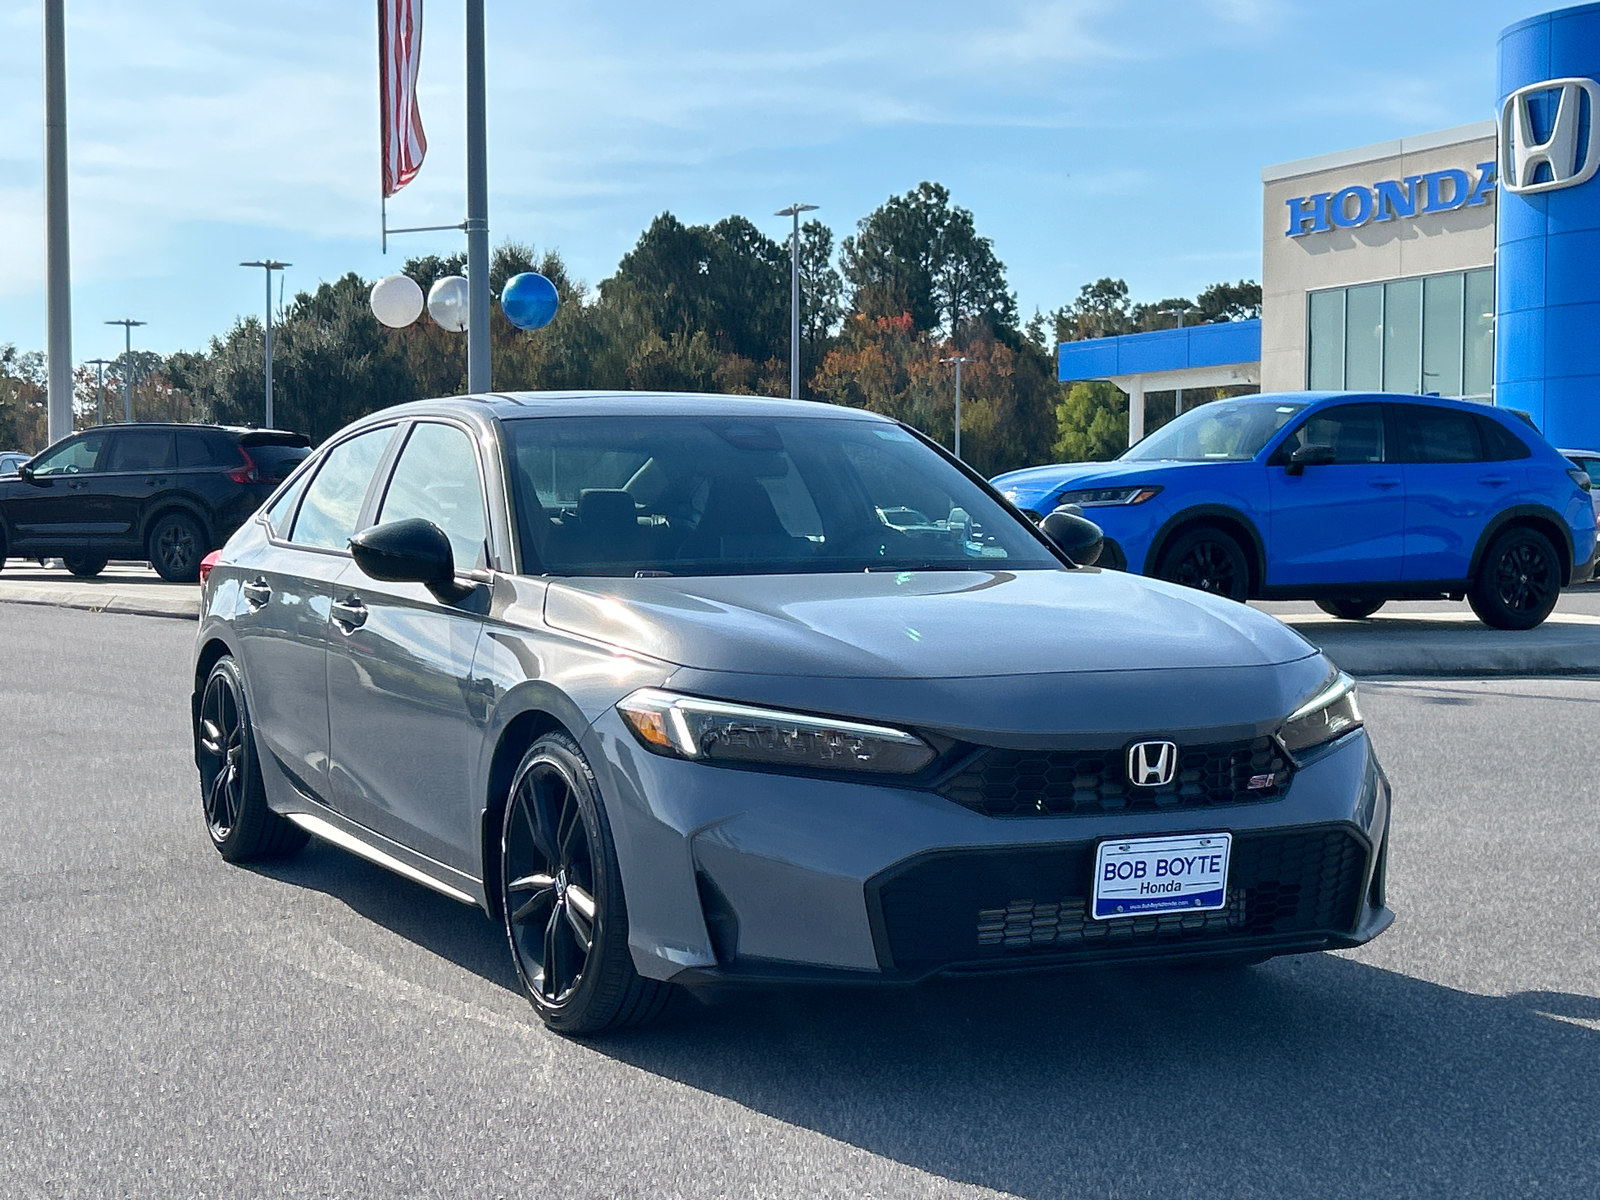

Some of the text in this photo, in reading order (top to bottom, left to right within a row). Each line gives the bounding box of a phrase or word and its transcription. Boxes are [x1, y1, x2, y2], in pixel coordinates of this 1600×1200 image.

[1285, 161, 1496, 237] HONDA
[1103, 854, 1222, 881] BOB BOYTE
[1139, 879, 1182, 895] Honda
